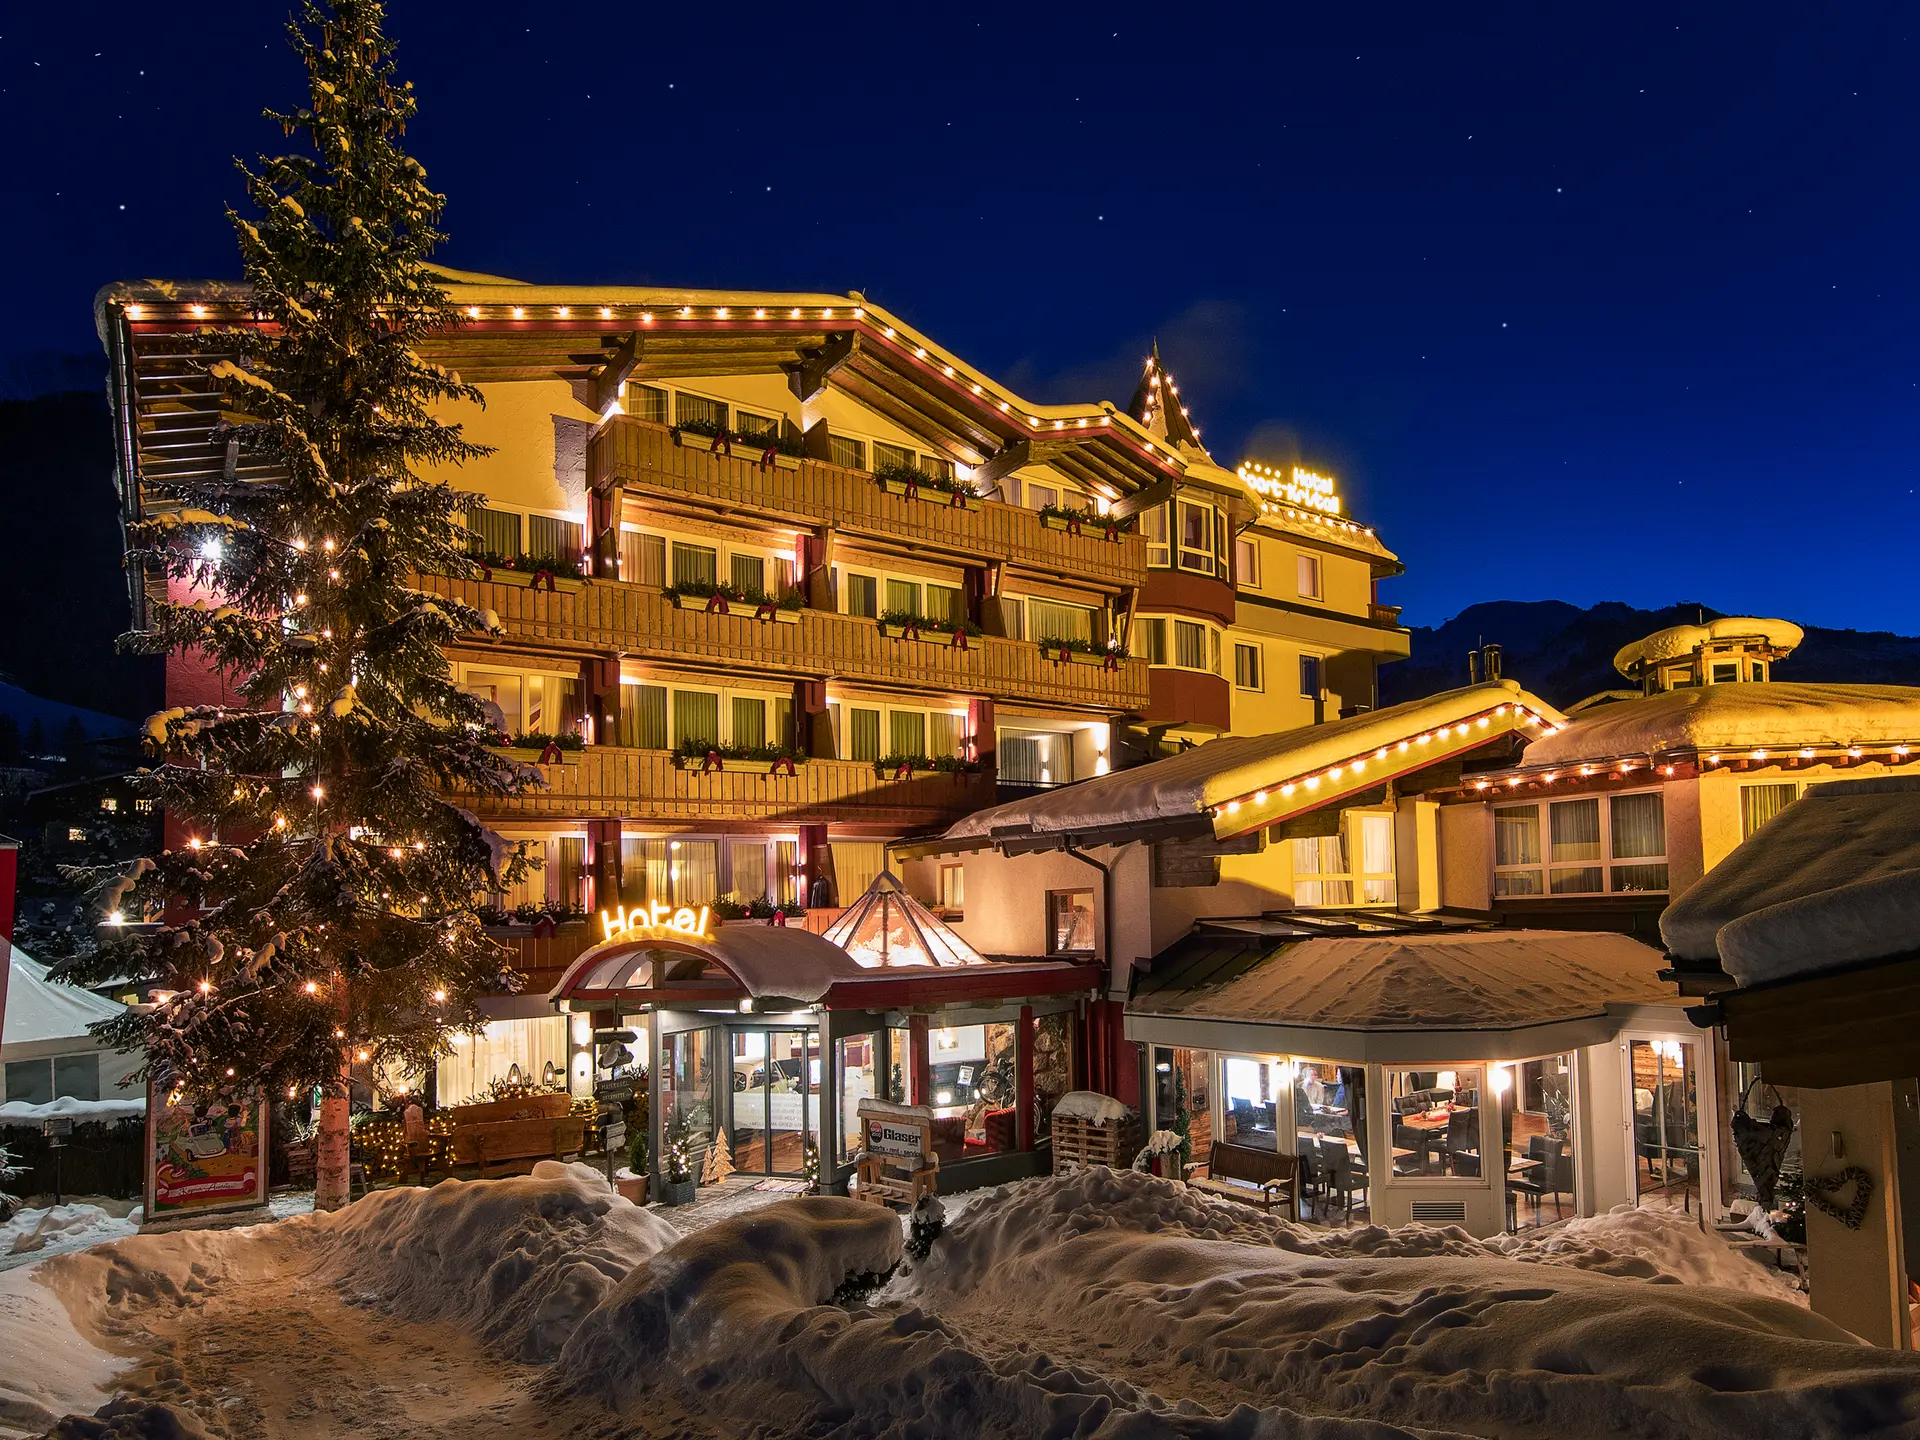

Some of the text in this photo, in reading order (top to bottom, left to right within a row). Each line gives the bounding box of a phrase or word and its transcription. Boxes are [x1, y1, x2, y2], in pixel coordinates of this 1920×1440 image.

[1293, 467, 1333, 495] Hotel
[601, 899, 709, 941] Hotel
[884, 1128, 921, 1143] Glaser
